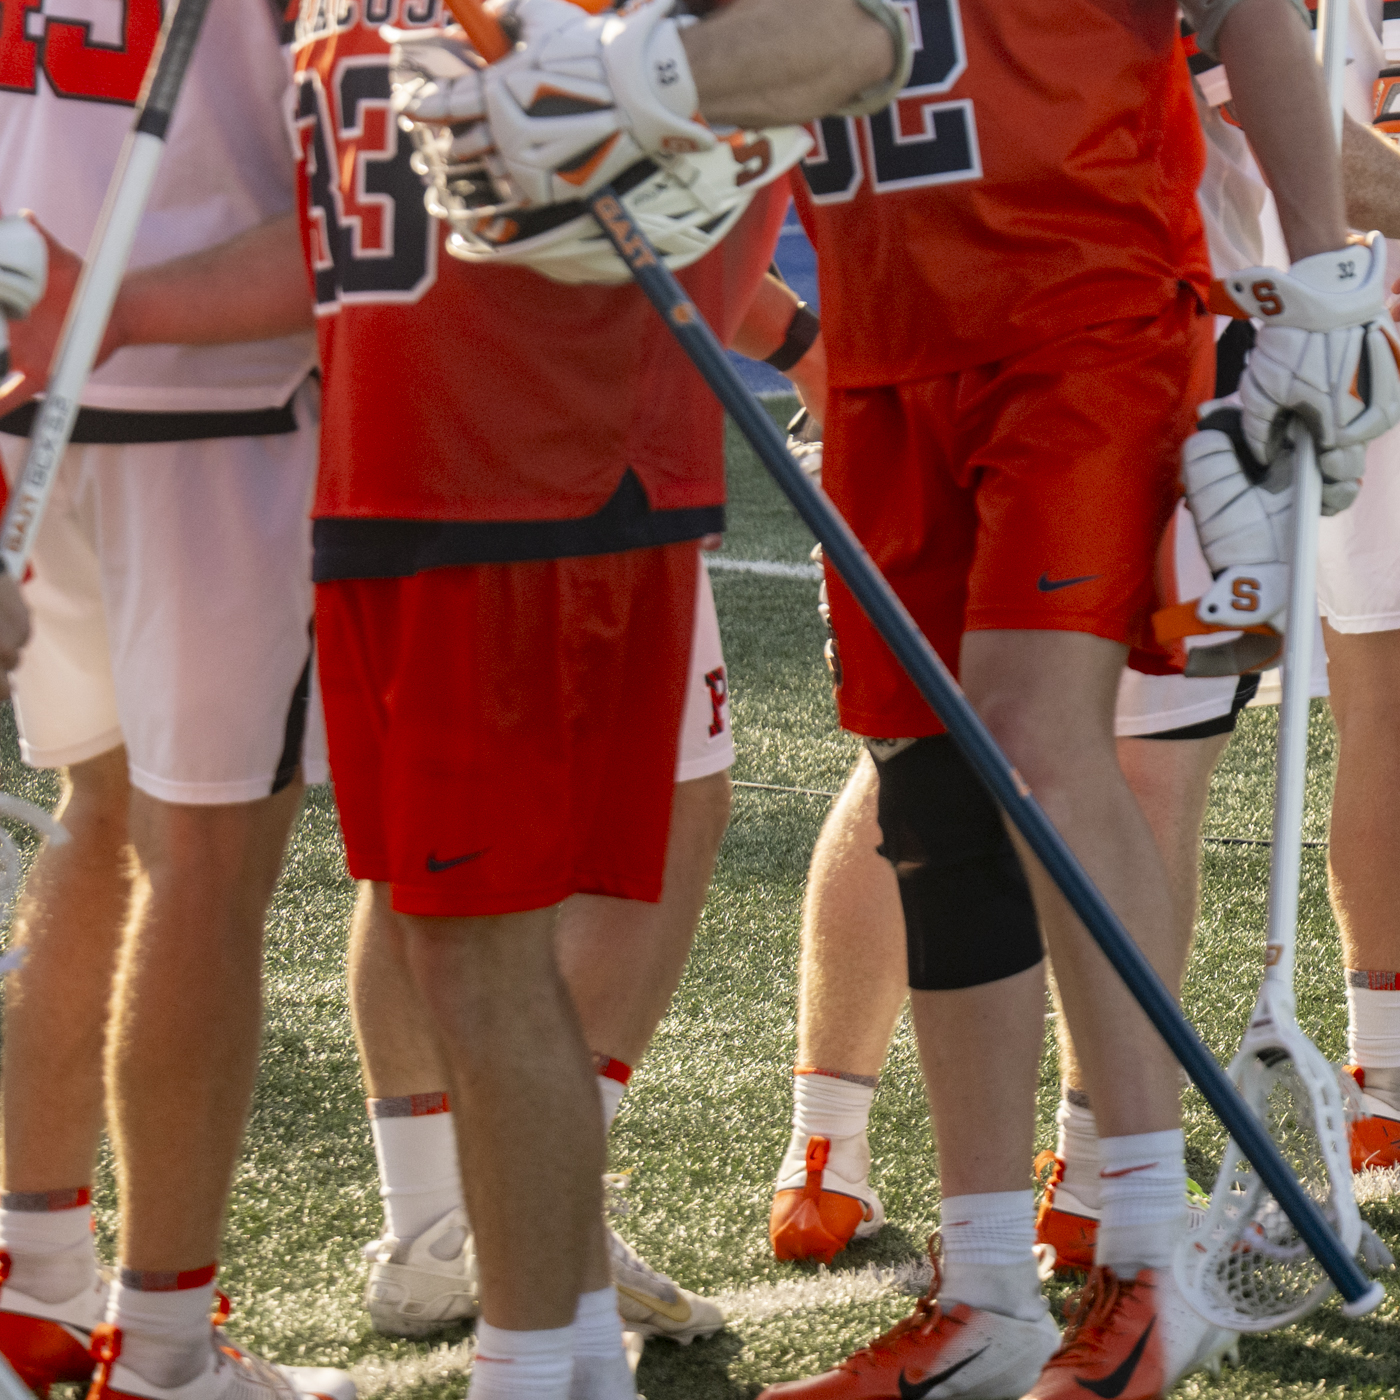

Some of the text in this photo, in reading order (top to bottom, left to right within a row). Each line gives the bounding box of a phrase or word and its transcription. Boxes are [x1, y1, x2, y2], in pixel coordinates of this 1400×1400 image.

[1337, 260, 1356, 280] 32
[1251, 278, 1284, 317] S
[1230, 575, 1262, 612] S
[703, 665, 728, 739] P
